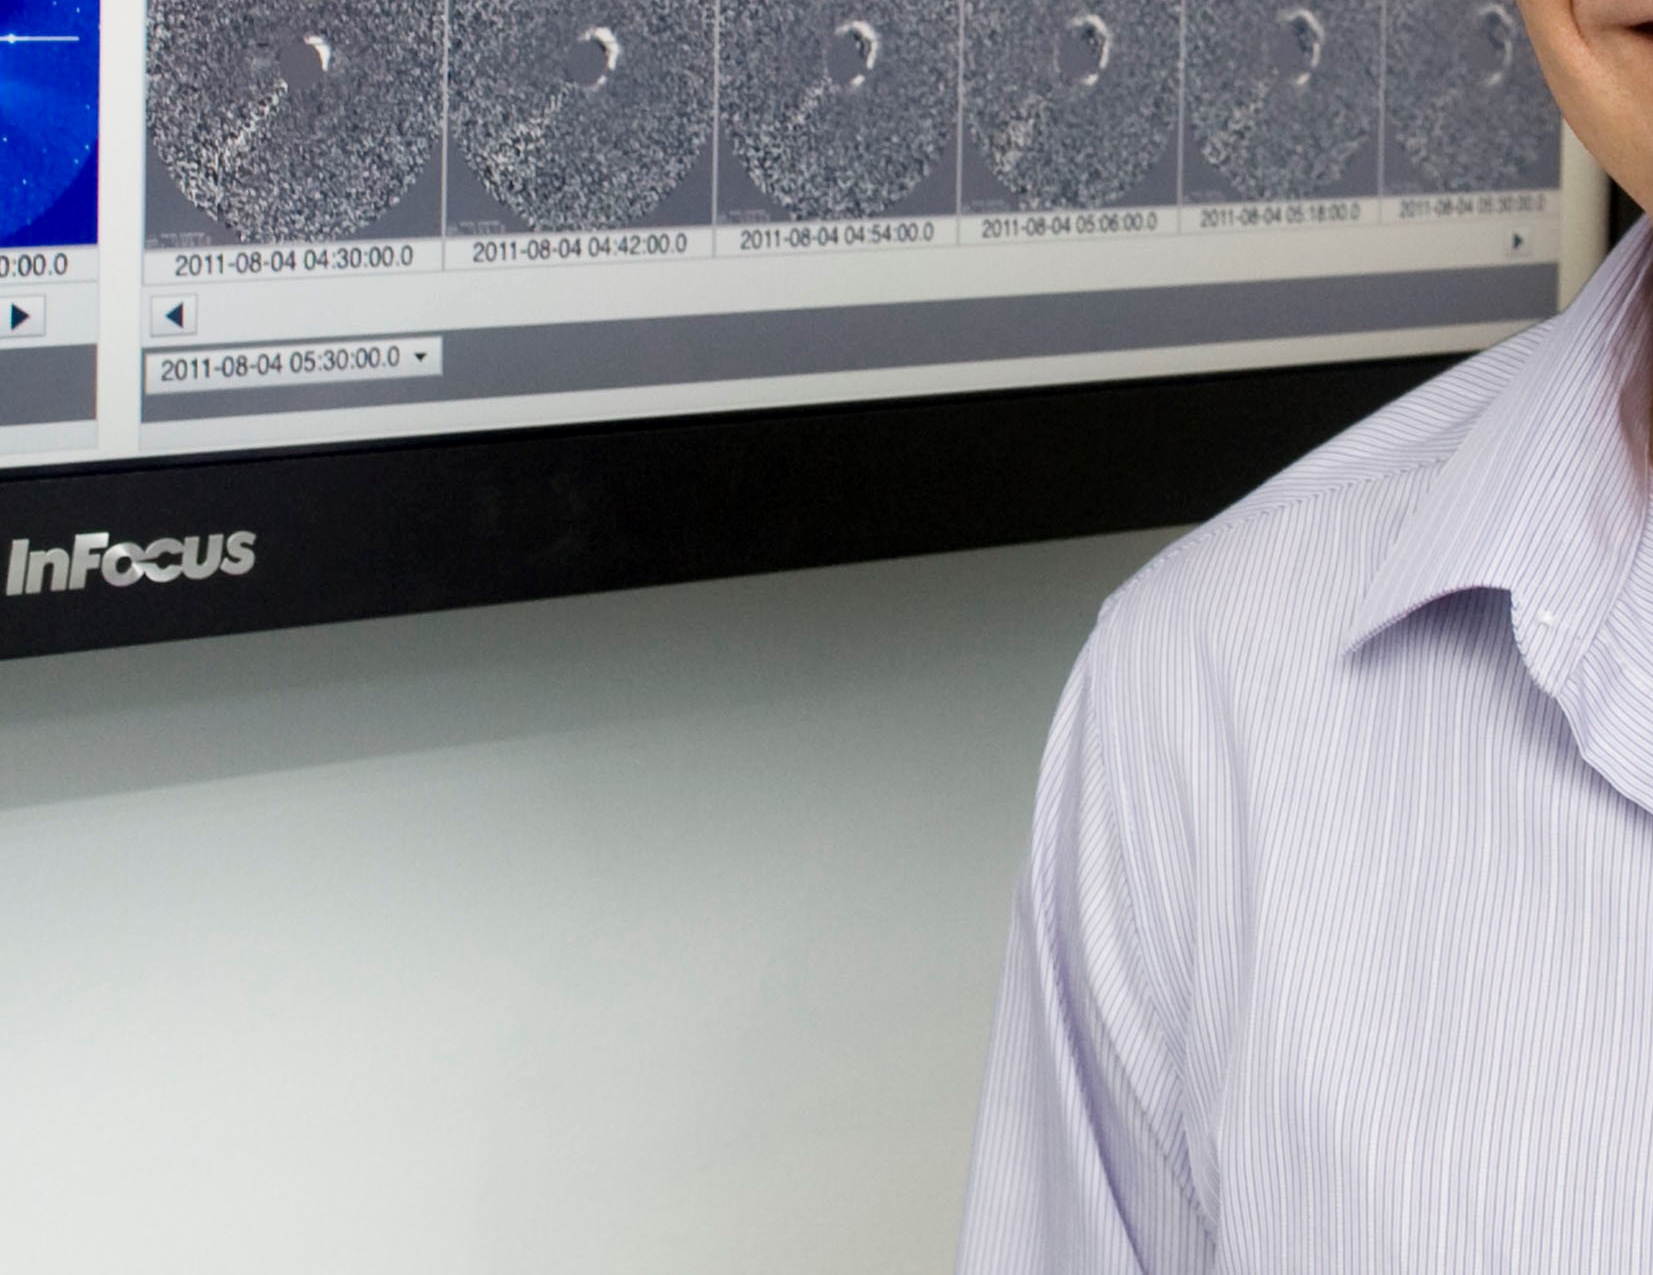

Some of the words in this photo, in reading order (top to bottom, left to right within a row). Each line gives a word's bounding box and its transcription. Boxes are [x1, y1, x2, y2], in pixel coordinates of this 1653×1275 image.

[981, 215, 1071, 239] 2011-08-04
[1075, 211, 1159, 235] 05:06:00.0
[1200, 206, 1281, 228] 2011-08-04
[472, 238, 582, 263] 2011-08-04
[587, 232, 688, 258] 04:42:00.0
[740, 227, 840, 251] 2011-08-04
[844, 222, 935, 245] 04:54:00.0
[175, 251, 296, 277] 2011-08-04
[304, 244, 414, 271] 04:30:00.0
[161, 352, 282, 381] 2011-08-04
[289, 345, 400, 375] 05:30:00.0
[6, 530, 256, 596] InFocus
